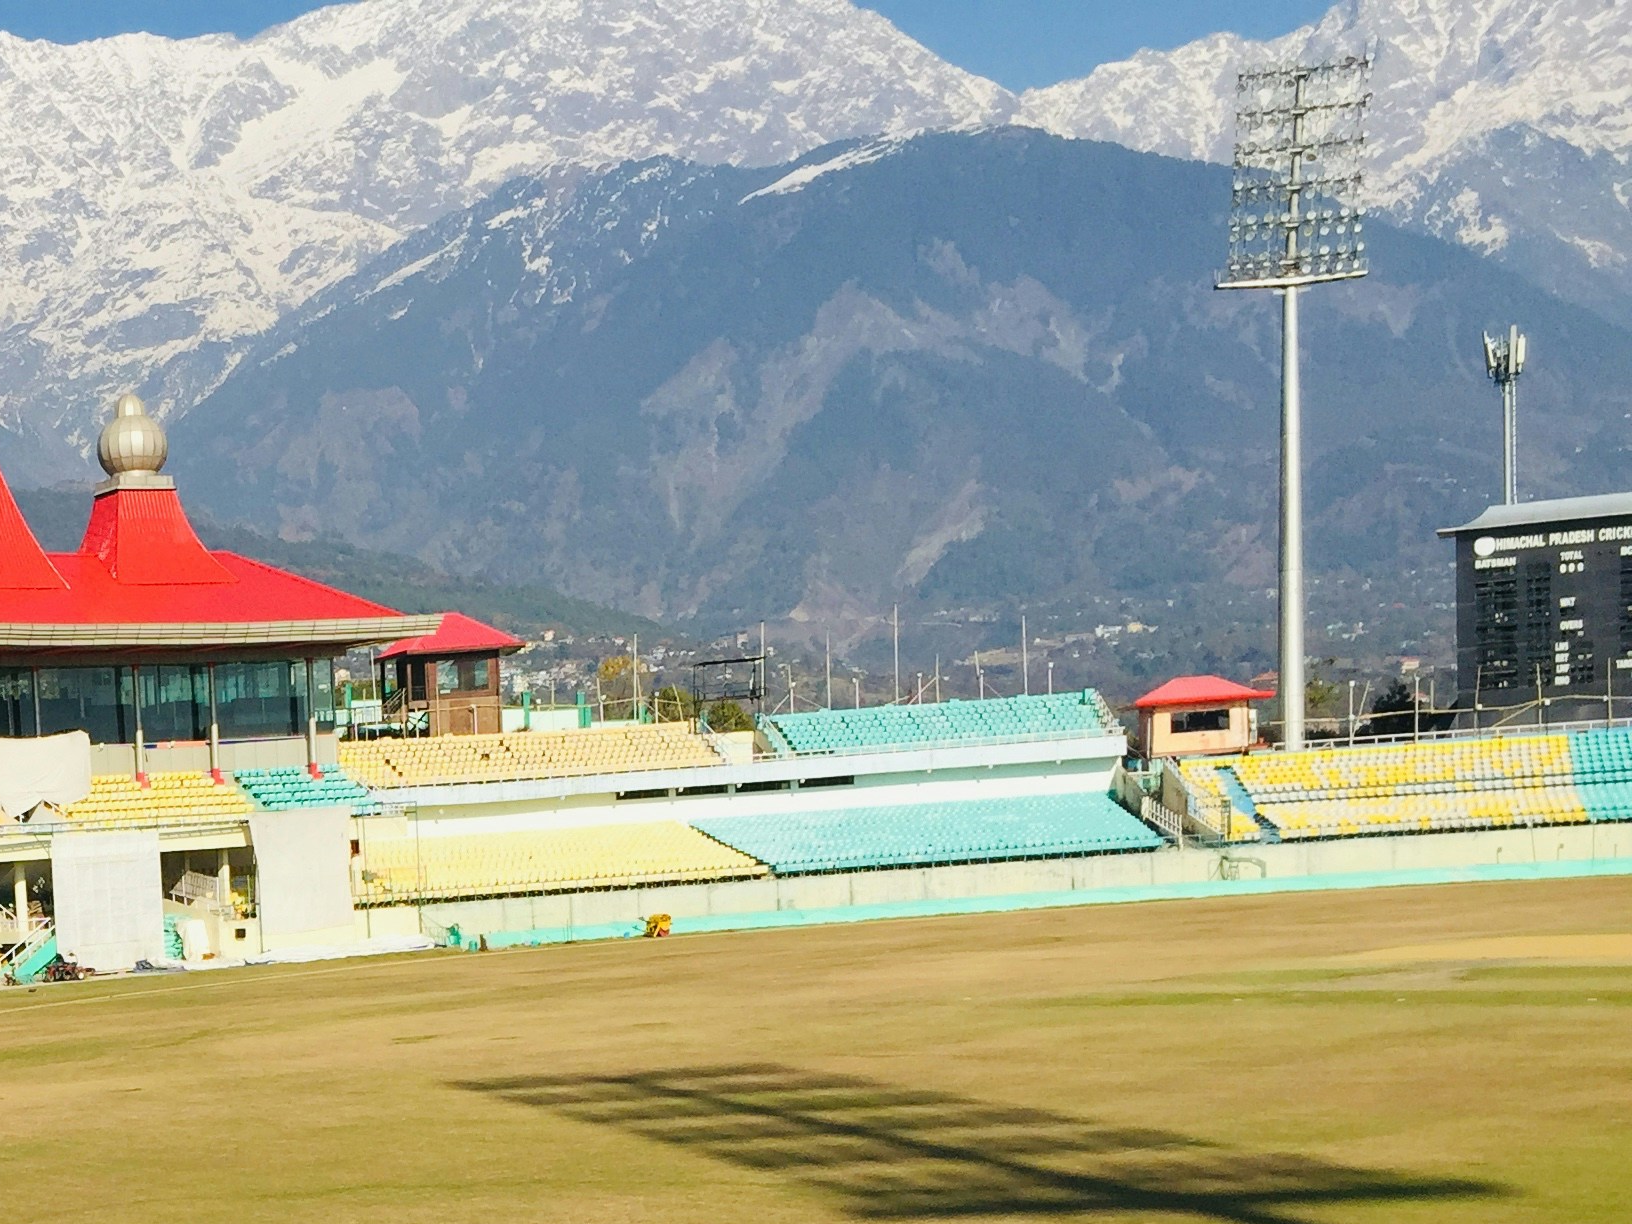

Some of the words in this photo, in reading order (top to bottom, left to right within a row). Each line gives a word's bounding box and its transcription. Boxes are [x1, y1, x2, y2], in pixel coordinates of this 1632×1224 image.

[1495, 534, 1546, 551] HIMACHAL
[1549, 529, 1595, 546] PRADESH
[1560, 550, 1584, 561] TOTAL
